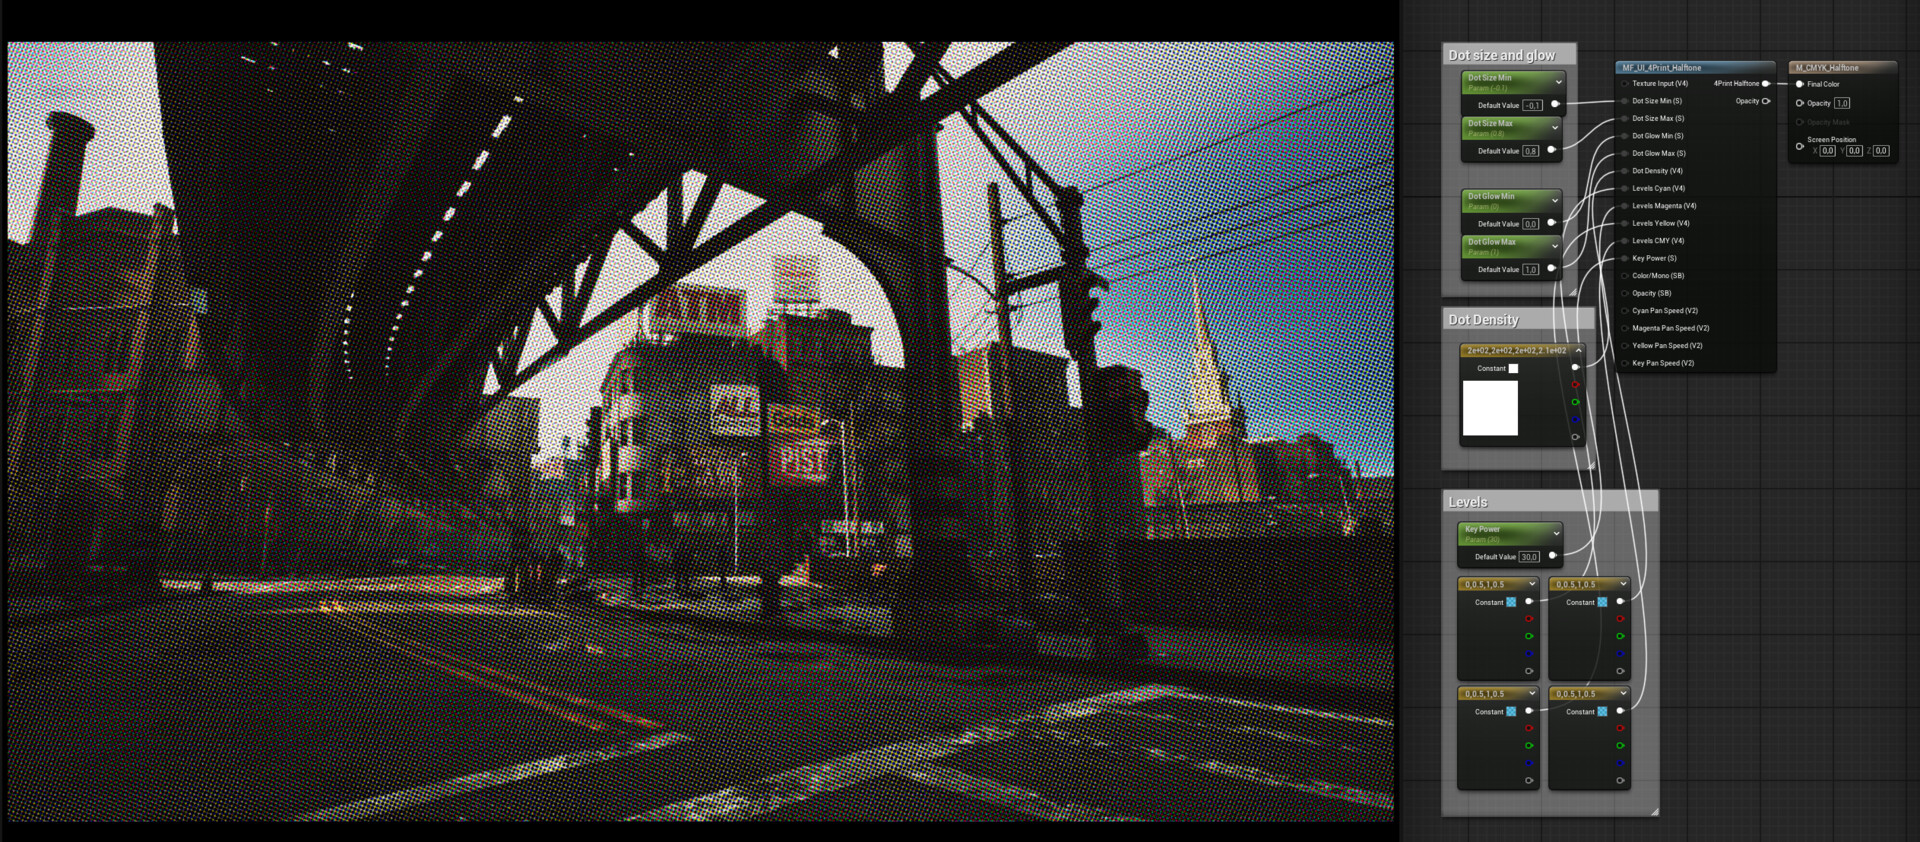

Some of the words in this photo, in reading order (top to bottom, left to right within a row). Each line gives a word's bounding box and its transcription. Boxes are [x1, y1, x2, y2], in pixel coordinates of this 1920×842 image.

[1449, 49, 1470, 61] Dot
[1473, 49, 1498, 61] size
[1501, 49, 1523, 61] and
[1526, 49, 1556, 64] glow
[1796, 63, 1859, 73] M_CMYK_Halftone
[1468, 73, 1481, 82] Dot
[1482, 73, 1497, 82] Size
[1498, 73, 1512, 82] Min
[1633, 79, 1656, 87] Texture
[1658, 80, 1674, 88] Input
[1675, 79, 1688, 88] (V4)
[1714, 79, 1732, 87] 4Print
[1734, 79, 1759, 87] Halftone
[1808, 80, 1822, 88] Final
[1823, 80, 1839, 88] Color
[1468, 84, 1489, 92] Param
[1490, 84, 1508, 93] (-0.1)
[1479, 101, 1500, 109] Default
[1502, 101, 1519, 109] Value
[1525, 101, 1540, 110] -0,1
[1633, 97, 1643, 105] Dot
[1645, 97, 1658, 105] Size
[1660, 97, 1671, 105] Min
[1673, 97, 1683, 106] (S)
[1736, 97, 1759, 106] Opacity
[1807, 99, 1831, 108] Opacity
[1838, 99, 1847, 109] 1,0
[1468, 119, 1481, 127] Dot
[1482, 119, 1497, 127] Size
[1498, 119, 1513, 127] Max
[1633, 114, 1643, 122] Dot
[1645, 114, 1658, 122] Size
[1660, 114, 1673, 122] Max
[1675, 114, 1684, 123] (S)
[1807, 118, 1831, 127] Opacity
[1833, 118, 1849, 126] Mask
[1468, 130, 1489, 138] Param
[1490, 130, 1505, 139] (0.8)
[1633, 132, 1643, 140] Dot
[1645, 132, 1660, 140] Glow
[1675, 132, 1684, 141] (S)
[1808, 135, 1830, 143] Screen
[1831, 135, 1856, 143] Position
[1479, 147, 1500, 155] Default
[1502, 147, 1519, 155] Value
[1525, 147, 1537, 157] 0,8
[1633, 149, 1643, 157] Dot
[1645, 149, 1660, 157] Glow
[1662, 149, 1675, 157] Max
[1677, 149, 1686, 158] (S)
[1823, 146, 1833, 155] 0,0
[1849, 146, 1860, 155] 0,0
[1876, 146, 1886, 155] 0,0
[1633, 167, 1643, 175] Dot
[1645, 167, 1668, 176] Density
[1670, 167, 1683, 176] (V4)
[1633, 184, 1653, 192] Levels
[1655, 184, 1671, 193] Cyan
[1672, 184, 1685, 193] (V4)
[1468, 192, 1481, 200] Dot
[1482, 192, 1500, 200] Glow
[1501, 192, 1515, 200] Min
[1490, 203, 1500, 211] (0)
[1633, 202, 1653, 210] Levels
[1655, 202, 1682, 211] Magenta
[1684, 202, 1696, 211] (V4)
[1479, 220, 1500, 228] Default
[1502, 220, 1519, 228] Value
[1525, 220, 1537, 230] 0,0
[1633, 219, 1653, 227] Levels
[1655, 219, 1675, 227] Yellow
[1677, 219, 1690, 228] (V4)
[1468, 238, 1481, 246] Dot
[1482, 238, 1500, 246] Glow
[1501, 238, 1516, 246] Max
[1671, 236, 1684, 246] (V4)
[1468, 248, 1489, 256] Param
[1490, 248, 1500, 257] (1)
[1633, 254, 1644, 263] Key
[1646, 254, 1666, 262] Power
[1668, 254, 1677, 263] (S)
[1479, 265, 1500, 273] Default
[1525, 266, 1537, 275] 1,0
[1671, 272, 1684, 281] (SB)
[1633, 289, 1656, 298] Opacity
[1658, 289, 1671, 298] (SB)
[655, 288, 740, 325] ATM
[1633, 307, 1649, 316] Cyan
[1650, 306, 1663, 314] Pan
[1664, 306, 1684, 316] Speed
[1685, 306, 1698, 316] (V2)
[1449, 314, 1471, 325] Dot
[1474, 314, 1519, 328] Density
[1633, 324, 1661, 333] Magenta
[1662, 324, 1674, 332] Pan
[1675, 324, 1695, 333] Speed
[1696, 324, 1710, 333] (V2)
[1655, 341, 1667, 349] Pan
[1669, 342, 1688, 351] Speed
[1690, 341, 1703, 351] (V2)
[1478, 364, 1506, 372] Constant
[1633, 359, 1645, 368] Key
[1646, 359, 1659, 367] Pan
[1660, 359, 1680, 368] Speed
[1681, 359, 1695, 368] (V2)
[780, 446, 829, 473] PIST
[1449, 496, 1488, 508] Levels
[1465, 525, 1477, 534] Key
[1479, 525, 1500, 533] Power
[1465, 536, 1486, 544] Param
[1487, 536, 1500, 545] (30)
[1475, 553, 1497, 561] Default
[1499, 553, 1516, 561] Value
[1521, 553, 1537, 563] 30,0
[1465, 580, 1505, 589] 0,0.5,1,0.5
[1556, 580, 1596, 589] 0,0.5,1,0.5
[1475, 598, 1503, 606] Constant
[1566, 598, 1595, 606] Constant
[1465, 690, 1505, 699] 0,0.5,1,0.5
[1556, 690, 1596, 699] 0,0.5,1,0.5
[1475, 708, 1503, 716] Constant
[1567, 708, 1595, 716] Constant
